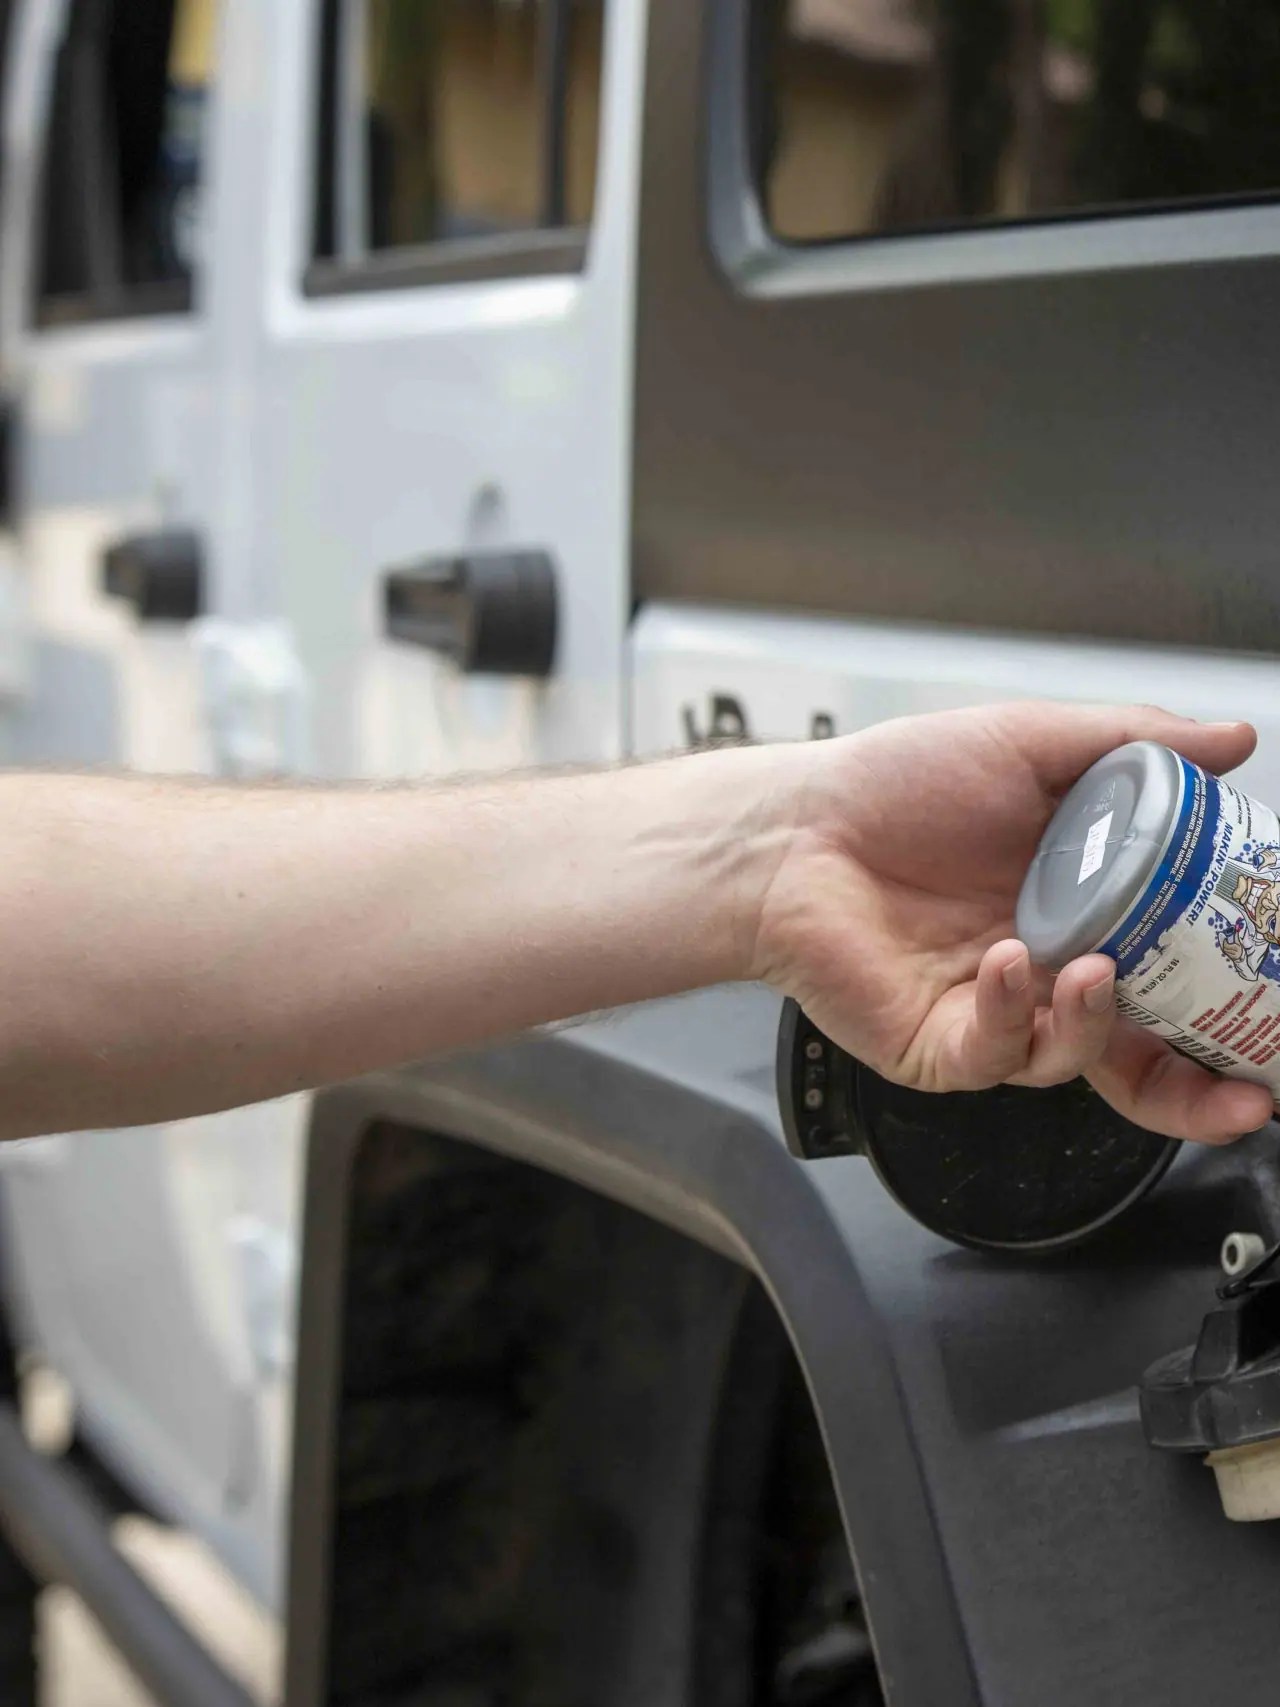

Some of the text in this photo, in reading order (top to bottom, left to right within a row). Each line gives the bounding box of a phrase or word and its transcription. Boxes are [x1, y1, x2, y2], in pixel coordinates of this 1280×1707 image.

[1181, 831, 1192, 848] VAPOR
[1190, 818, 1203, 848] PETROLEUM
[1159, 880, 1170, 893] CALL
[1186, 870, 1219, 925] POWER!
[1142, 894, 1163, 922] PHYSICIAN
[1152, 884, 1177, 920] COMBUSTIBLE
[1156, 971, 1167, 981] OZ
[1163, 964, 1174, 973] FL
[1213, 991, 1243, 1022] INCREASES
[1238, 983, 1267, 1017] KNOCKING
